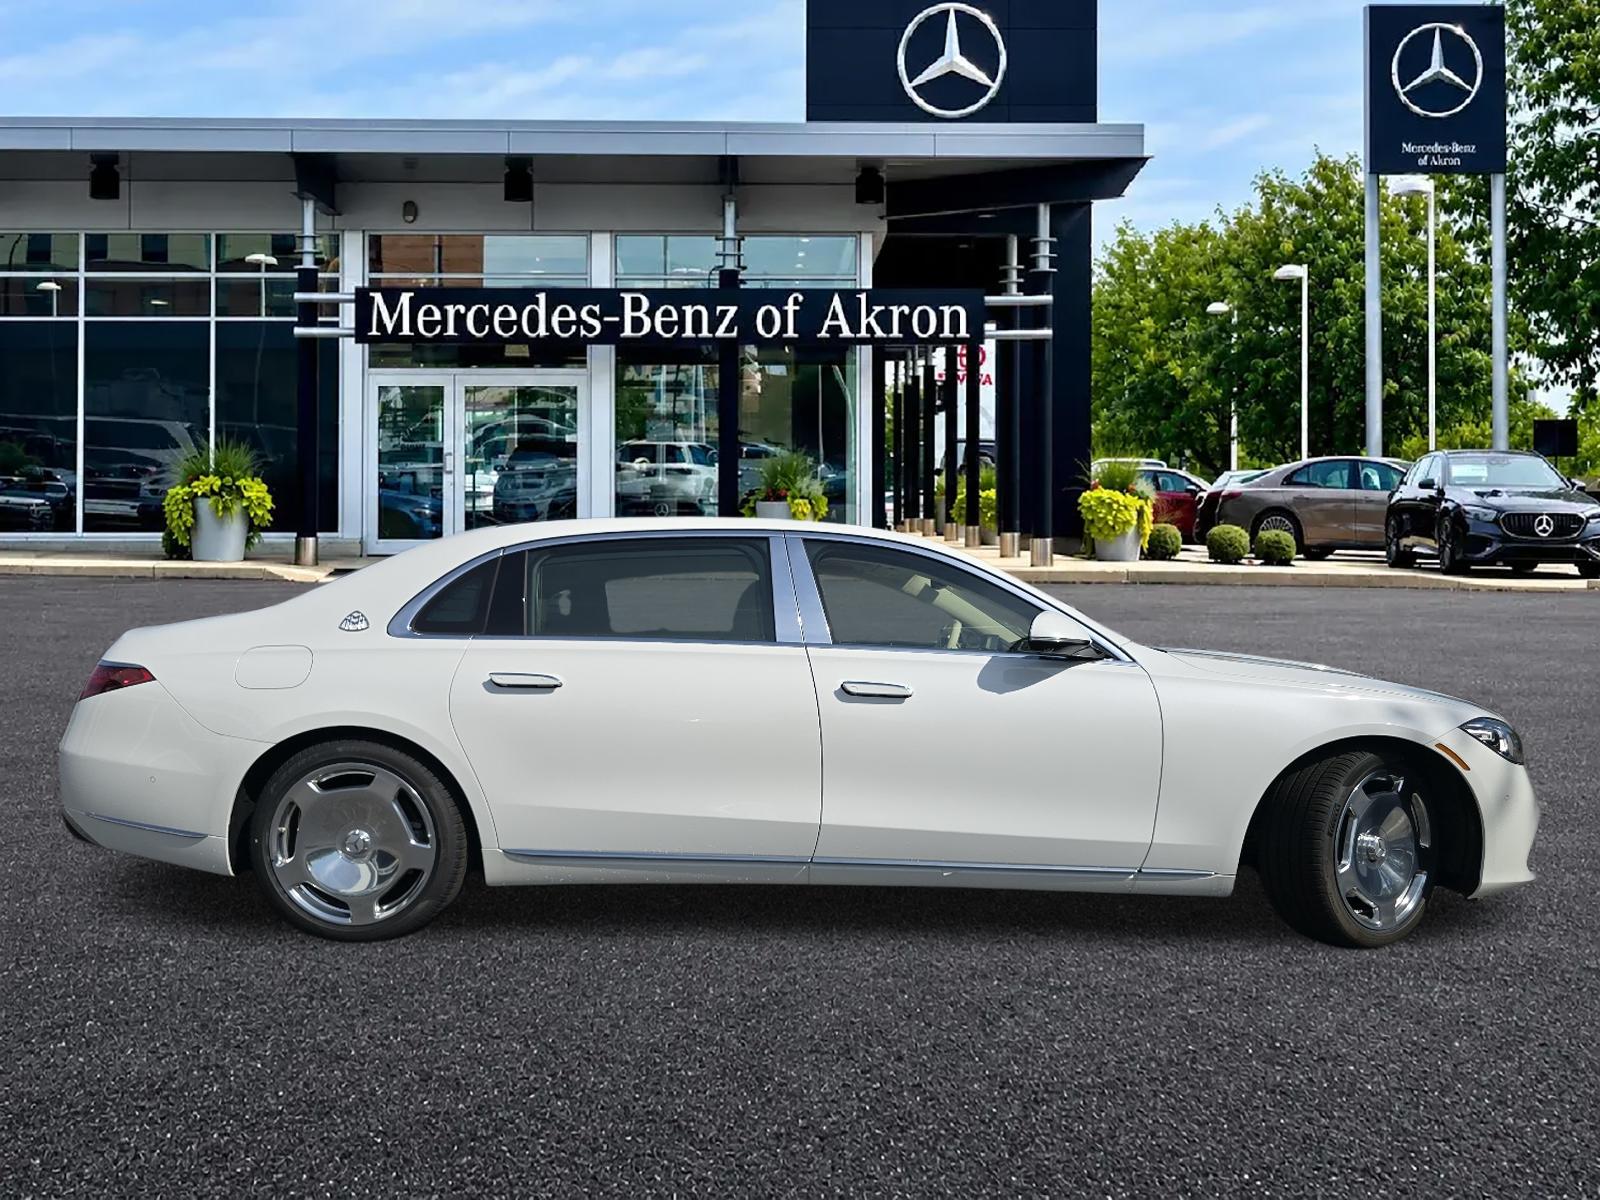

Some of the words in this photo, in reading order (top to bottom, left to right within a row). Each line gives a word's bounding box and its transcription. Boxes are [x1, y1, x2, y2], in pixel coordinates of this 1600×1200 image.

[1401, 141, 1476, 153] Mercedes-Benz
[1417, 154, 1428, 166] of
[1430, 154, 1461, 166] Akron
[367, 291, 738, 338] Mercedes-Benz
[755, 291, 804, 338] of
[816, 291, 970, 338] Akron
